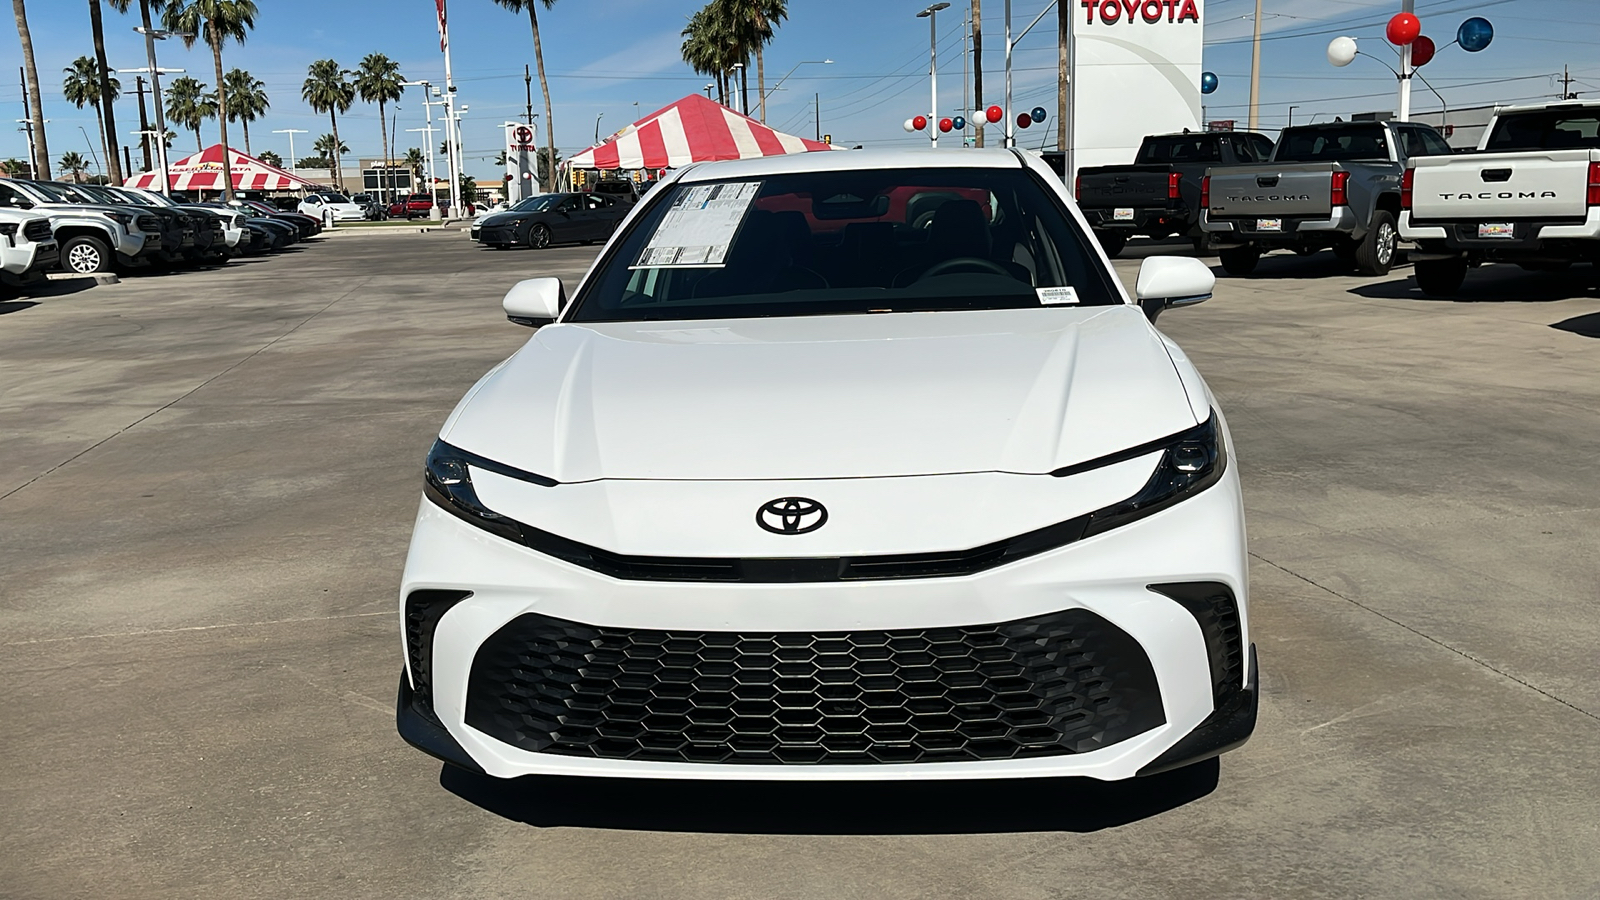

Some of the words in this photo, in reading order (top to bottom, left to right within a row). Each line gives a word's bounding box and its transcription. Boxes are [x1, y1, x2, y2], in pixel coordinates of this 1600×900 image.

[1080, 0, 1199, 25] TOYOTA
[1226, 194, 1310, 202] TACOMA
[1438, 191, 1556, 200] TACOMA
